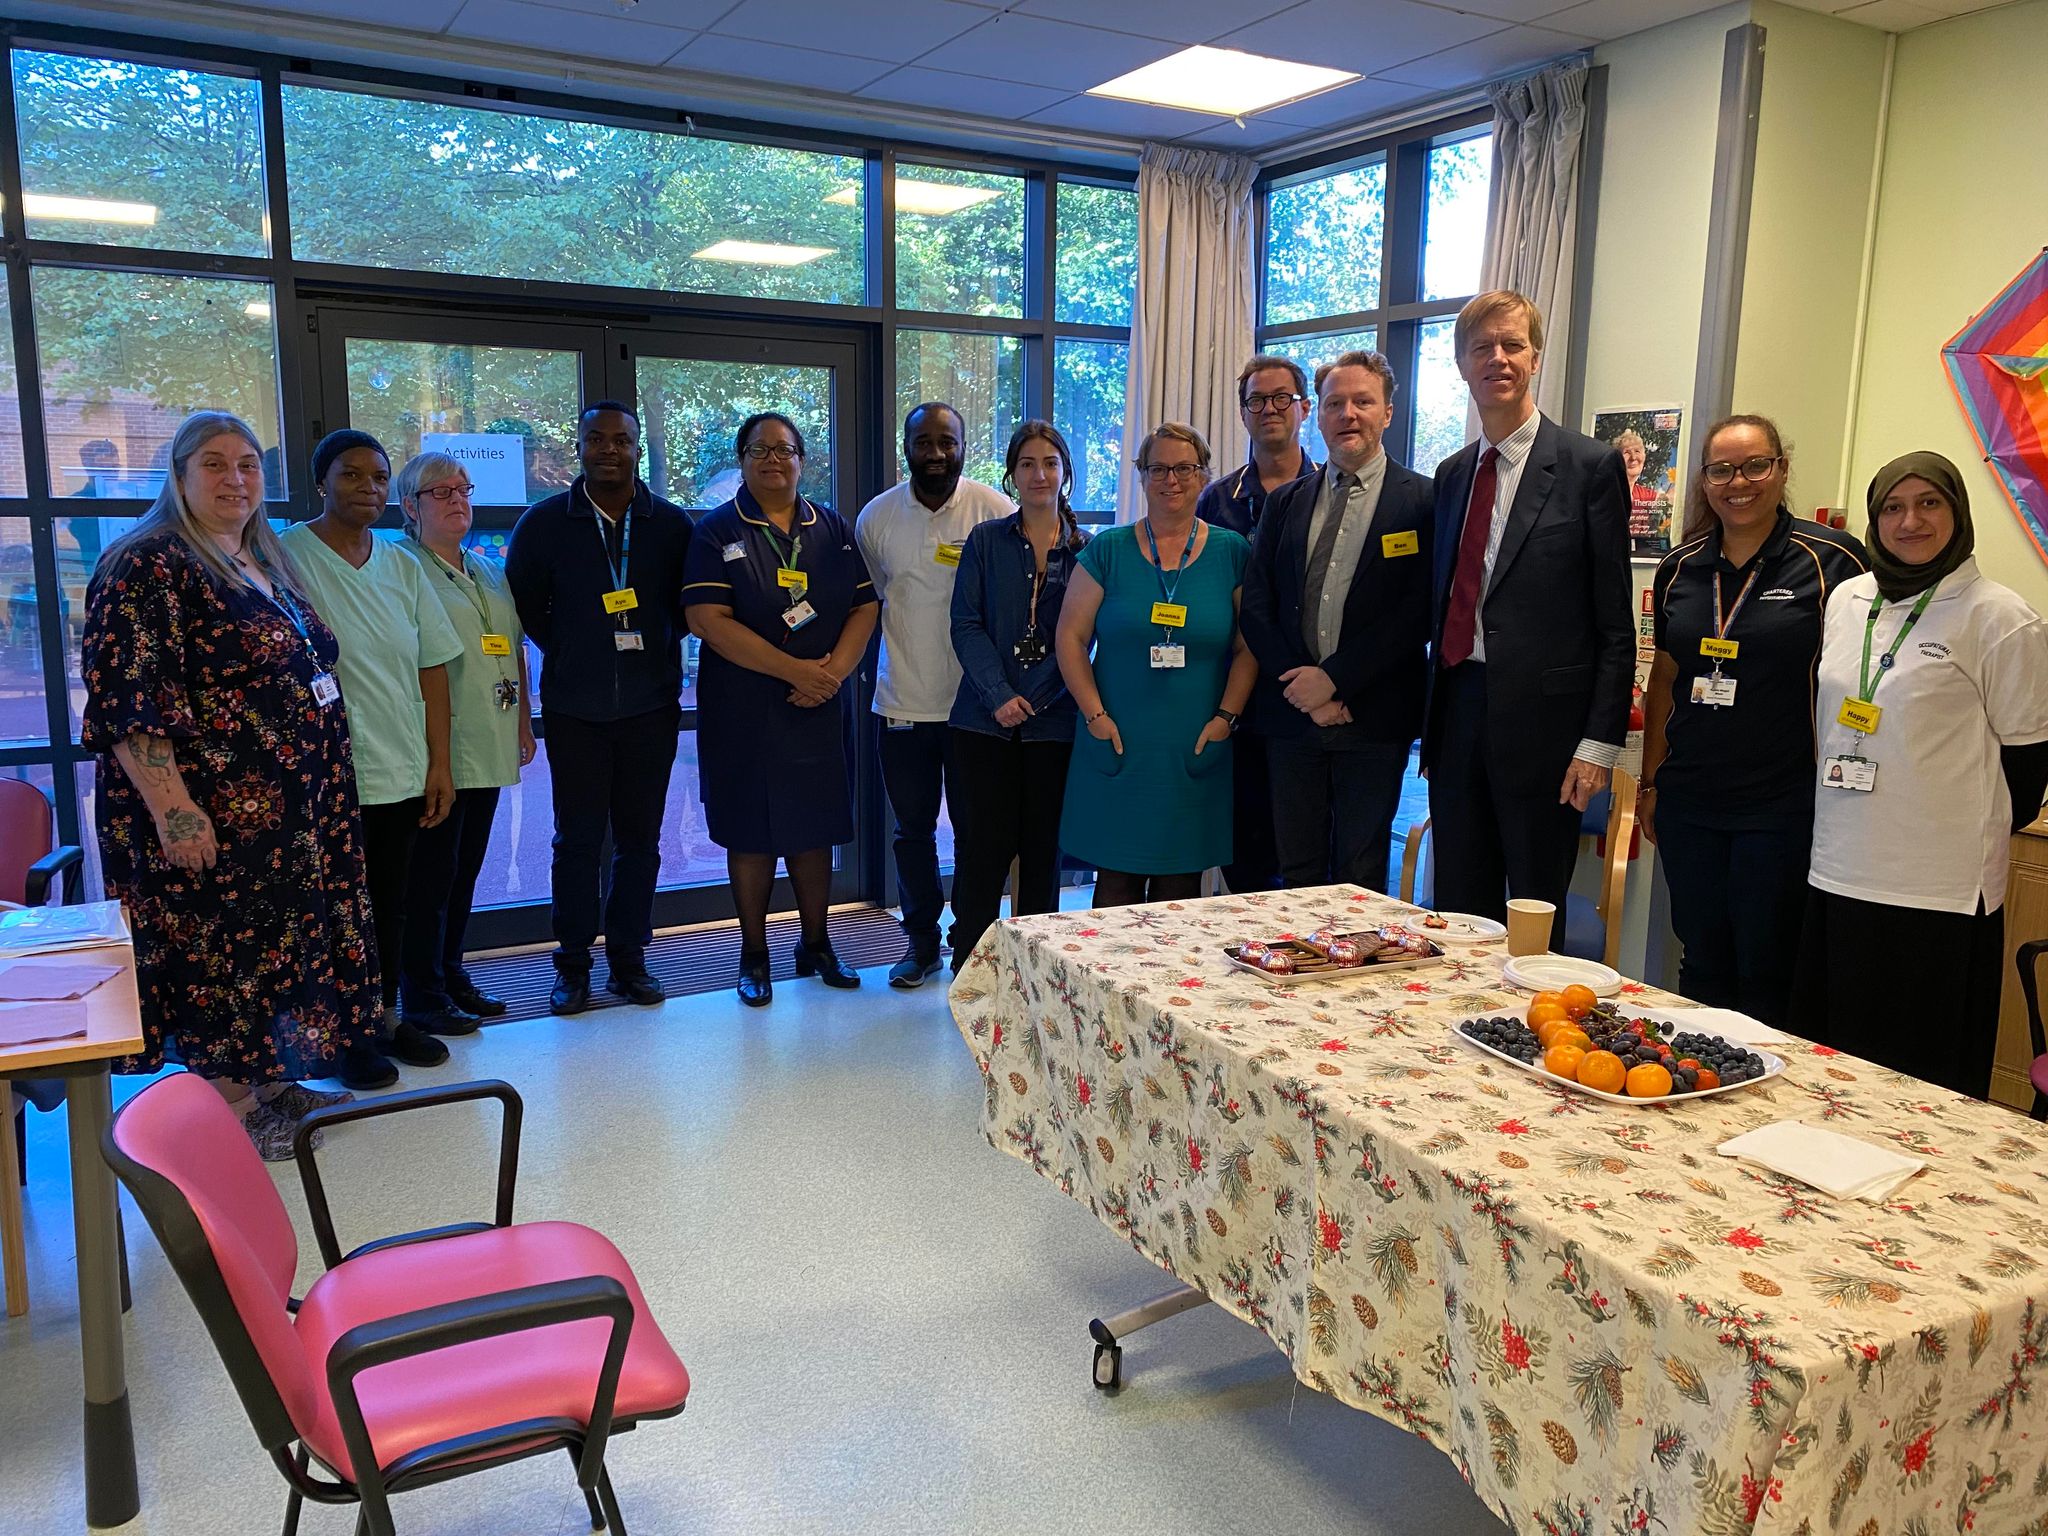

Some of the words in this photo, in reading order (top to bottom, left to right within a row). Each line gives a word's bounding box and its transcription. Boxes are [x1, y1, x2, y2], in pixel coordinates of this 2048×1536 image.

[444, 447, 505, 460] Activities
[1634, 499, 1667, 509] Therapists
[1157, 612, 1181, 620] Joanna
[1706, 644, 1732, 655] Maggy
[1918, 642, 1952, 656] OCCUPATIONAL
[1920, 649, 1945, 660] THERAPIST
[1847, 710, 1870, 724] Happy
